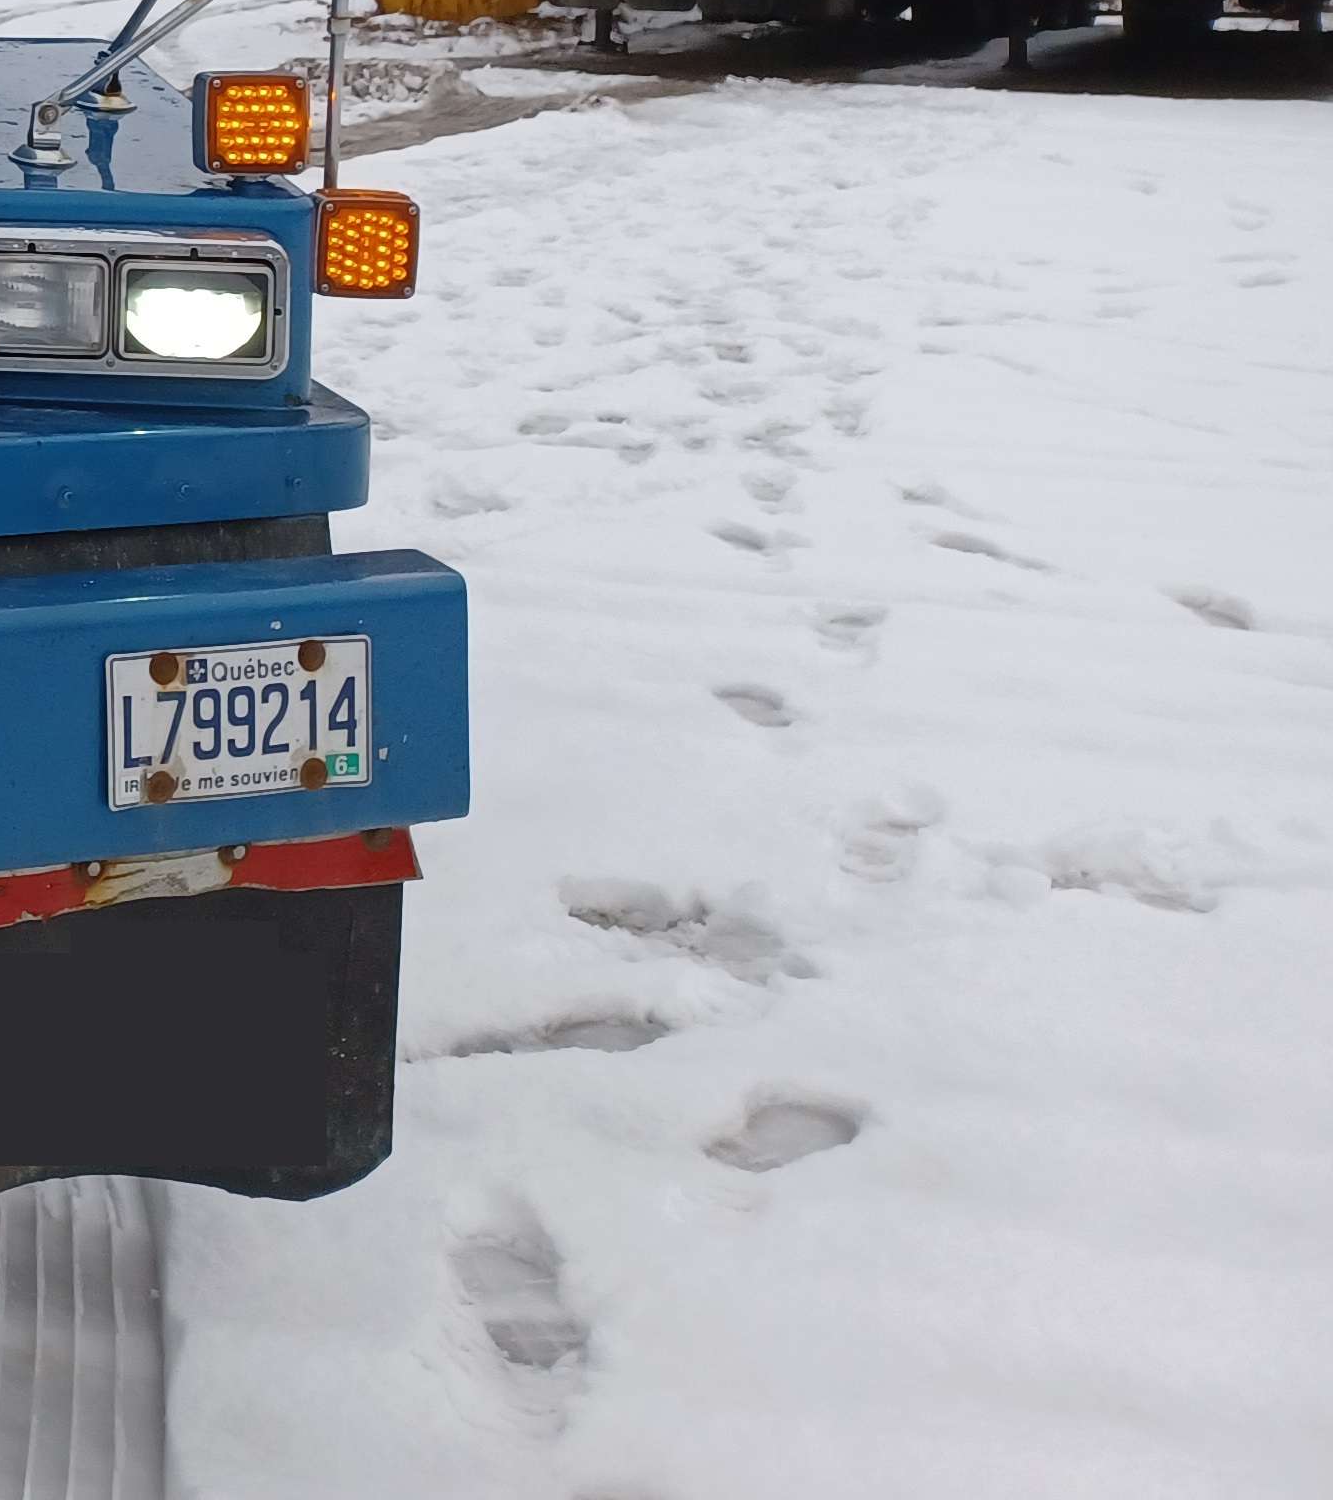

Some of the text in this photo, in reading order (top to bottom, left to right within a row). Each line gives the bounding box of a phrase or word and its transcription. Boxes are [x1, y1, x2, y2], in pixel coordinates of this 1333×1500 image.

[211, 657, 295, 684] Québec
[122, 675, 358, 770] L799214
[198, 773, 224, 790] me
[230, 765, 301, 787] souvien
[334, 755, 349, 775] 6
